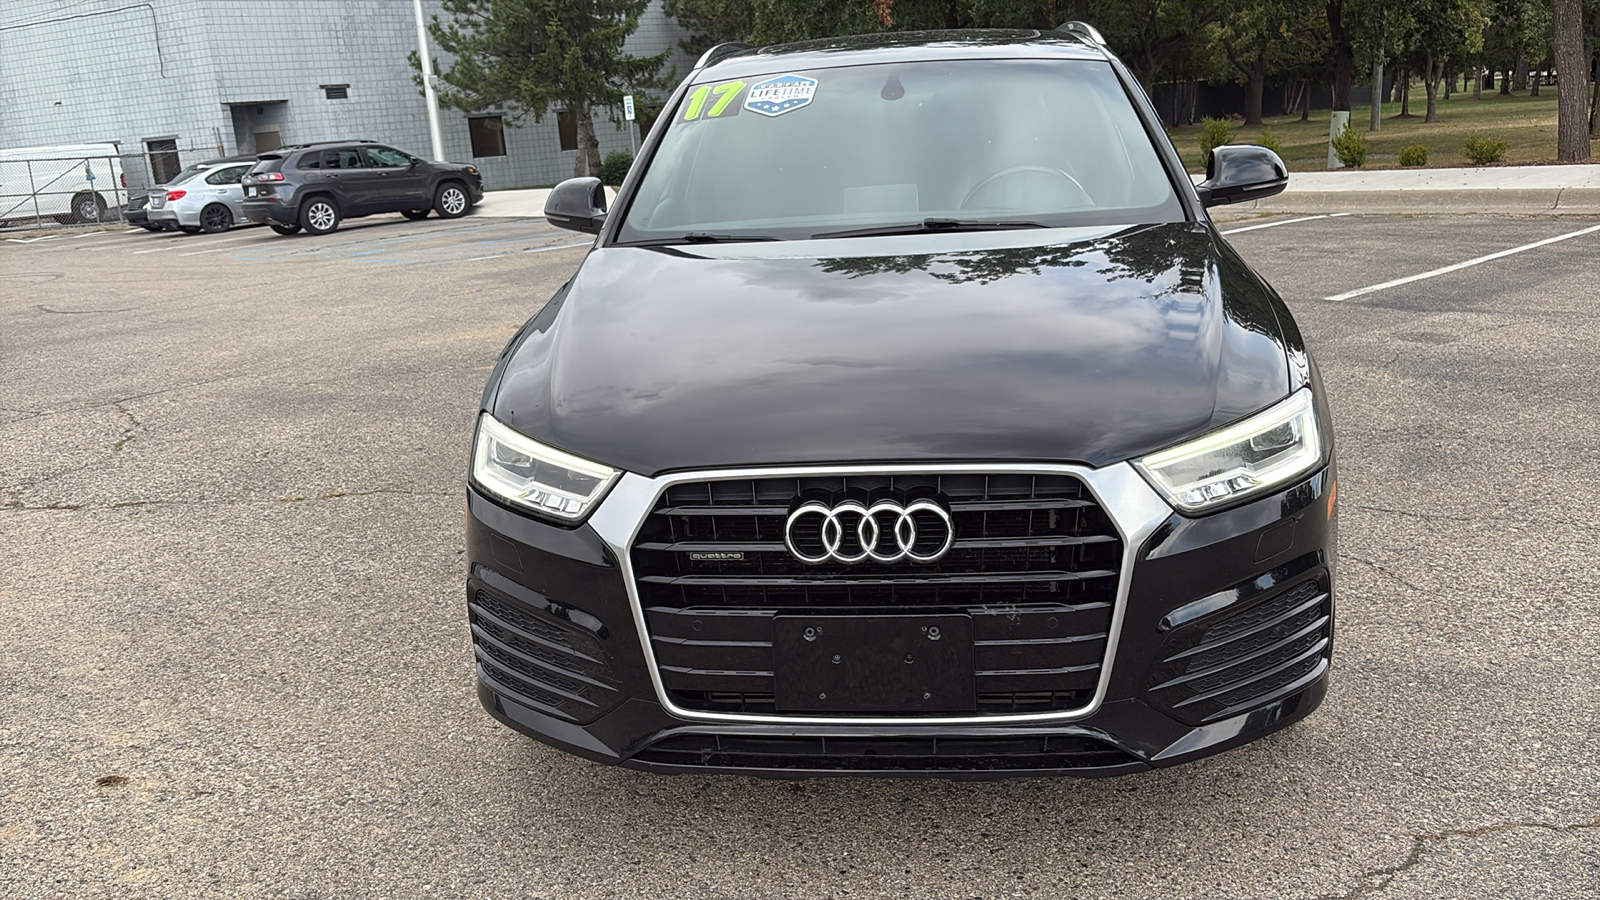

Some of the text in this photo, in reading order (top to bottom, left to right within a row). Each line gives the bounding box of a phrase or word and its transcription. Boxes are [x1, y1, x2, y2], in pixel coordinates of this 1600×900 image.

[750, 87, 813, 98] LIFETIME
[683, 80, 747, 121] 17
[692, 552, 741, 560] quattro
